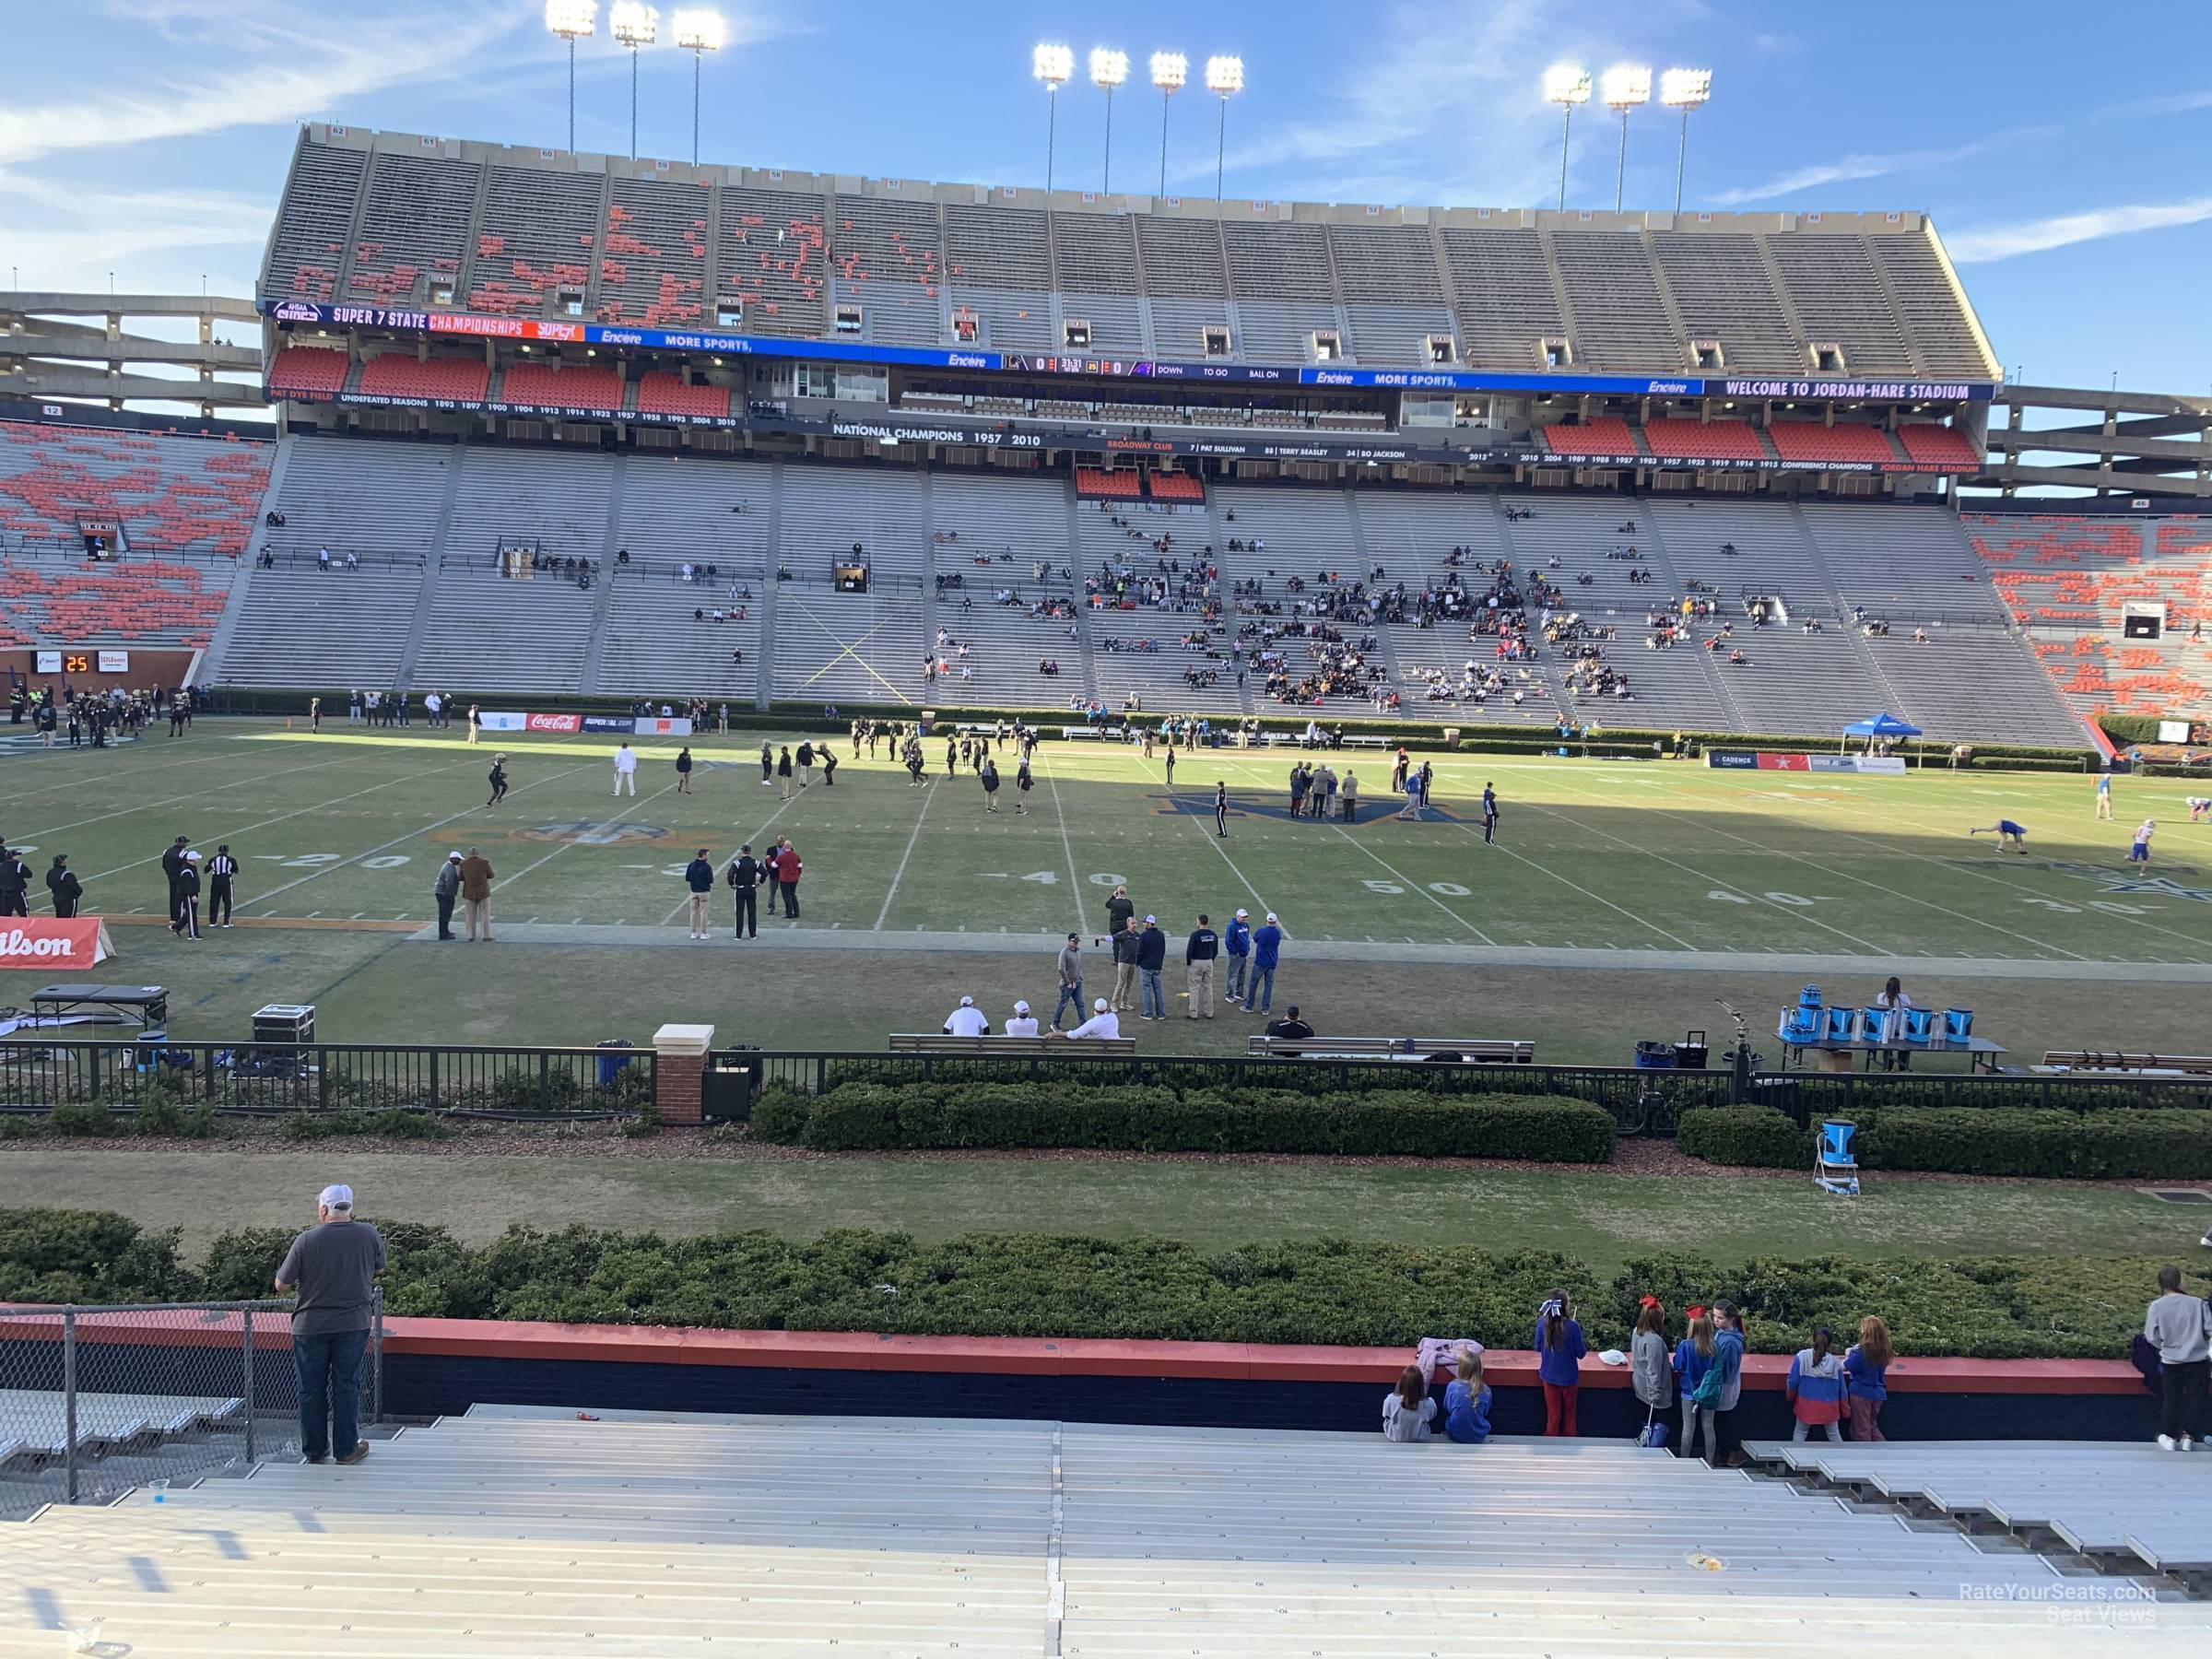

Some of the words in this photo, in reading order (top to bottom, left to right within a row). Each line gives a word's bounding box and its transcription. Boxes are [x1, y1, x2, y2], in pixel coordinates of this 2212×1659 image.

[334, 307, 374, 324] SUPER
[377, 311, 386, 325] 7
[388, 312, 426, 329] STATE
[429, 317, 523, 335] CHAMPIONSHIPS
[601, 330, 642, 345] Encore
[665, 335, 700, 348] MORE
[704, 338, 752, 353] SPORTS,
[948, 354, 986, 368] Encore
[1036, 358, 1045, 370] 0
[1061, 358, 1082, 368] 31:31
[1113, 362, 1121, 374] 0
[1158, 366, 1183, 375] DOWN
[1214, 368, 1228, 377] GO
[1249, 370, 1265, 378] BALL
[1316, 372, 1353, 384] Encore
[1375, 374, 1408, 385] MORE
[1410, 375, 1457, 388] SPORTS,
[1648, 381, 1687, 393] Encore
[1726, 381, 1788, 396] WELCOME
[1792, 382, 1809, 396] TO
[1813, 383, 1906, 398] JORDAN-HARE
[1910, 384, 1969, 399] STADIUM
[310, 392, 333, 400] FIELD
[341, 394, 390, 405] UNDEFEATED
[392, 397, 428, 407] SEASONS
[435, 400, 454, 408] 1893
[461, 401, 481, 410] 1897
[488, 403, 507, 412] 1900
[514, 405, 533, 413] 1904
[540, 406, 559, 415] 1913
[566, 408, 585, 417] 1914
[592, 410, 611, 418] 1932
[617, 412, 636, 420] 1957
[642, 413, 661, 422] 1958
[667, 415, 686, 424] 1993
[692, 417, 711, 425] 2004
[717, 418, 736, 427] 2010
[833, 424, 892, 437] NATIONAL
[894, 428, 963, 441] CHAMPIONS
[974, 432, 1002, 444] 1957
[1012, 435, 1041, 446] 2010
[1107, 440, 1151, 450] BROADWAY
[1153, 442, 1172, 450] CLUB
[1782, 461, 1827, 470] CONFERENCE
[1828, 463, 1873, 471] CHAMPIONS
[1941, 465, 1979, 473] STADIUM
[66, 656, 88, 672] 25
